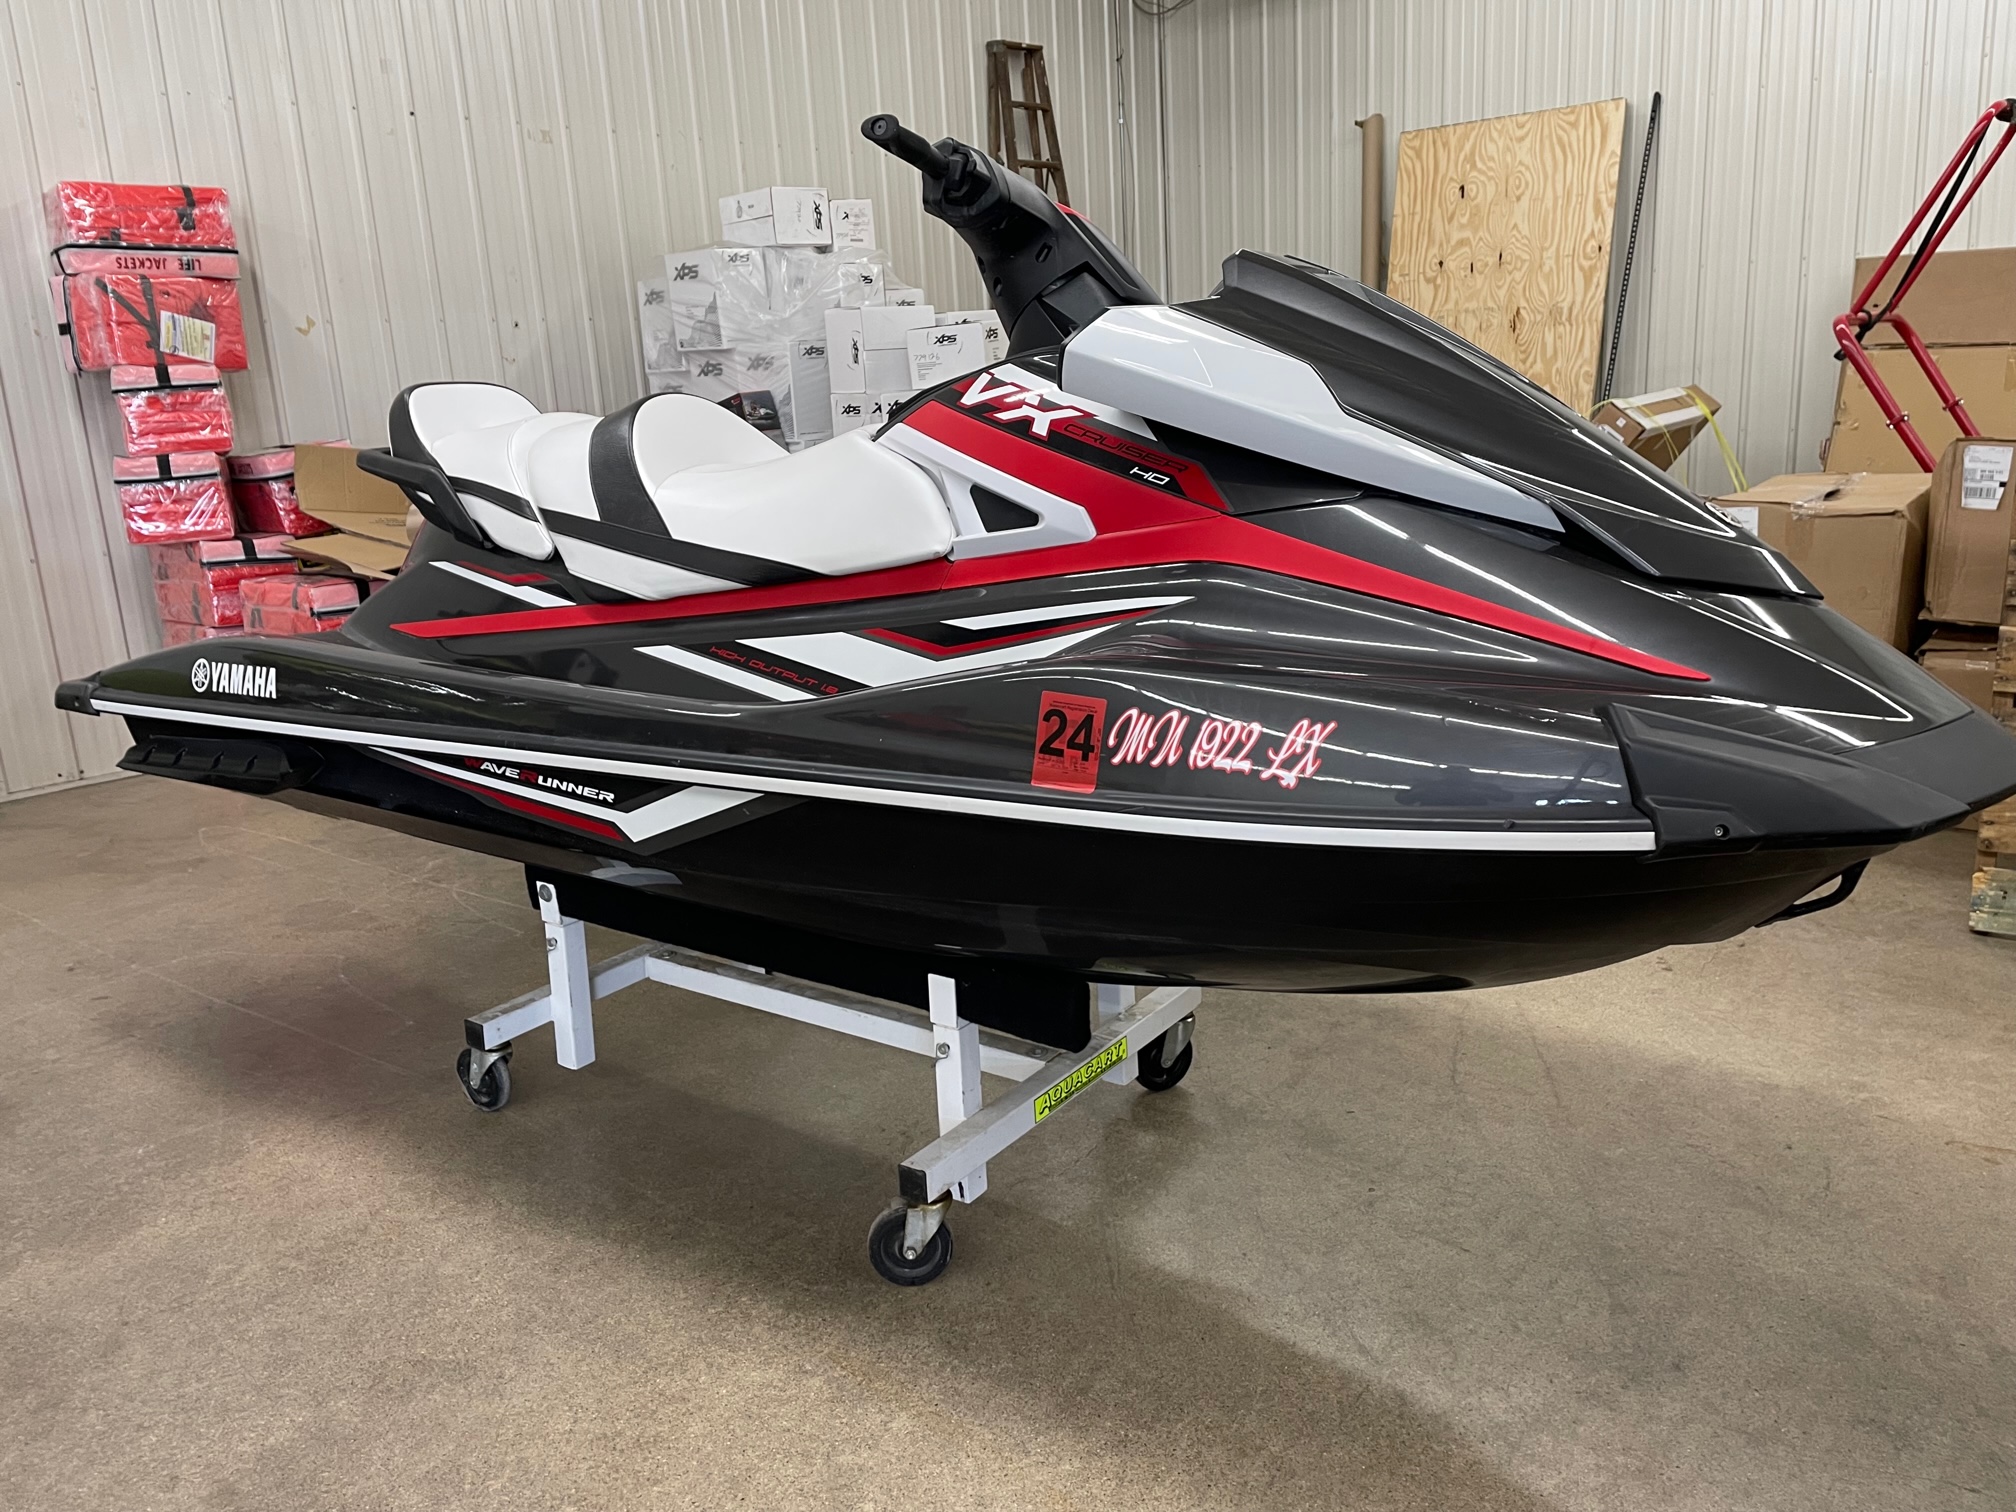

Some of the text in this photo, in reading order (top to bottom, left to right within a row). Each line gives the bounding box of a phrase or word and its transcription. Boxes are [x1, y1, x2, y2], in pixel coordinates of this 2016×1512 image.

[813, 200, 824, 232] XPS
[115, 255, 202, 271] LIFE JACKETS
[673, 262, 699, 281] XPS
[643, 288, 665, 306] XPS
[933, 333, 957, 345] XPS
[985, 326, 999, 341] XPS
[746, 354, 775, 371] XPS
[802, 345, 825, 356] XPS
[697, 360, 723, 377] XPS
[841, 404, 862, 415] XPS
[959, 371, 1085, 438] VX
[1063, 423, 1189, 473] CRUISER
[709, 645, 746, 663] HIGH
[748, 659, 819, 686] OUTPUT
[211, 661, 277, 699] YAMAHA
[1038, 708, 1096, 762] 24
[1107, 706, 1190, 768] MN
[1187, 718, 1263, 775] 1922
[1259, 717, 1338, 790] LX
[463, 757, 615, 803] WAVERUNNER
[1038, 1041, 1122, 1115] AQUACART
